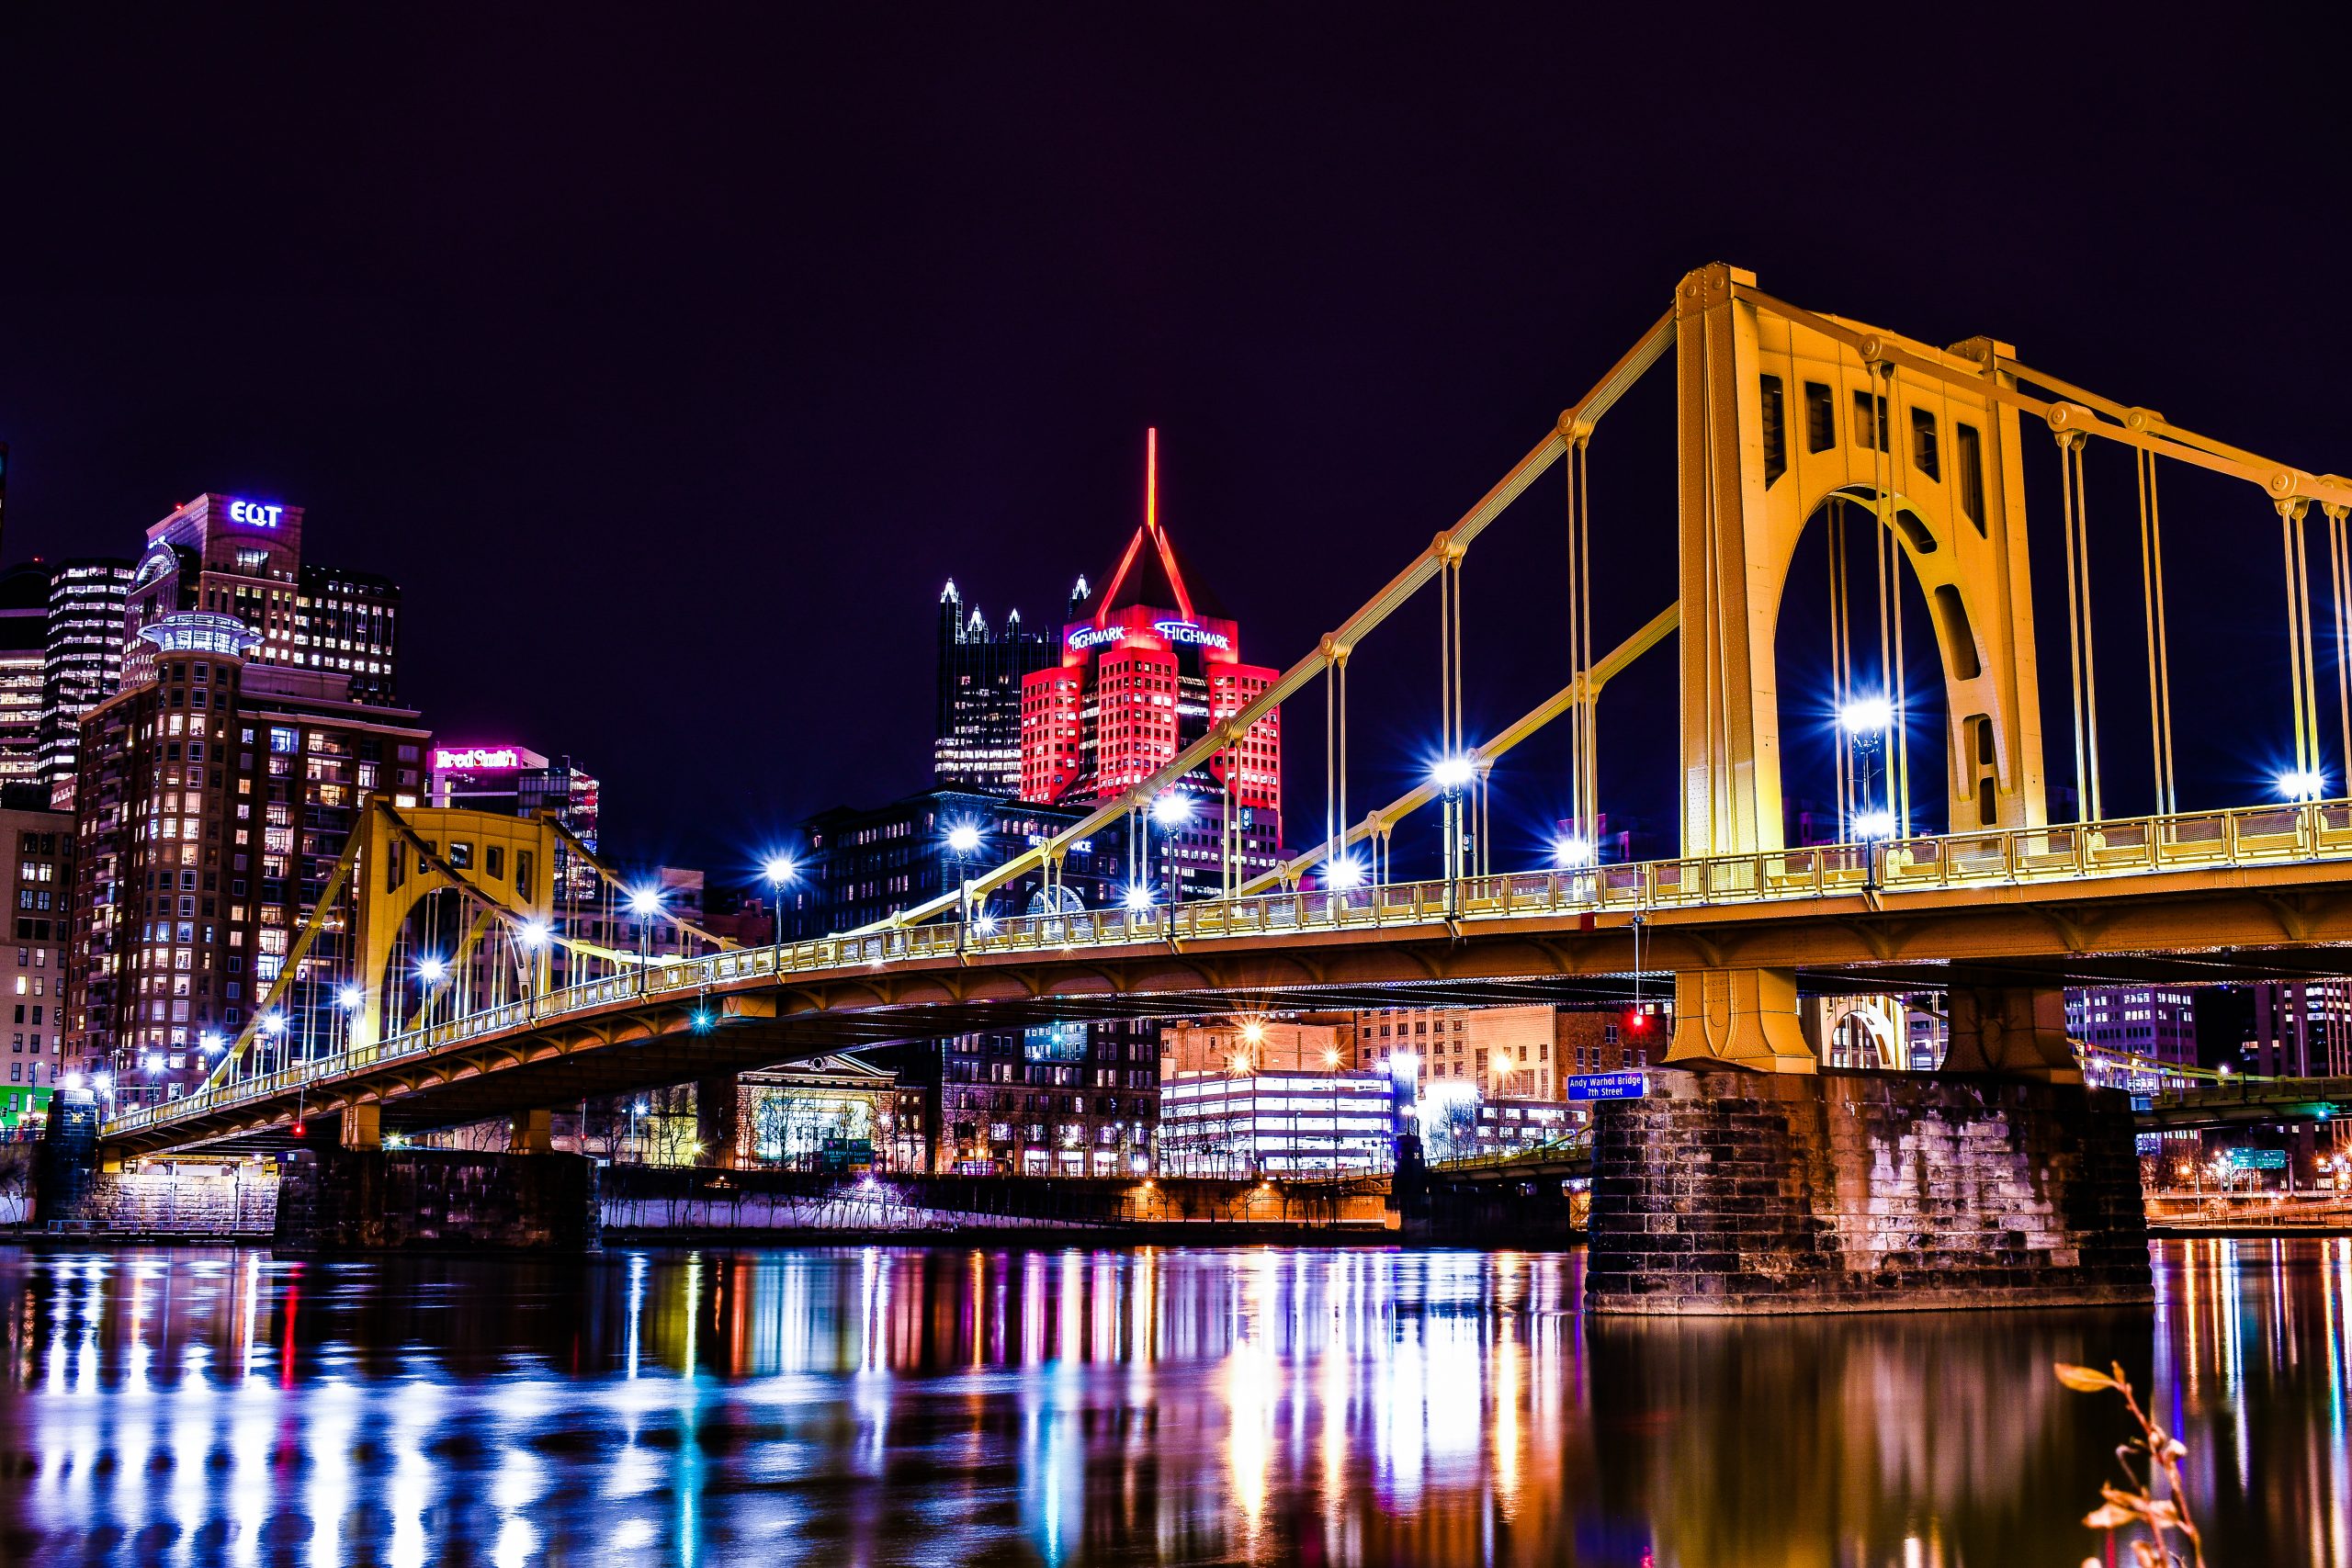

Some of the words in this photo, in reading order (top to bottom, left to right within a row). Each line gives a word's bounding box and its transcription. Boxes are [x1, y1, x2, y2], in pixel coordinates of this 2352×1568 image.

[231, 501, 282, 527] EQT
[1069, 626, 1125, 651] HIGHMARK
[1154, 620, 1230, 650] HIGHMARK
[1569, 1078, 1588, 1089] Andy
[1589, 1077, 1615, 1087] Warhol
[1617, 1076, 1642, 1087] Bridge
[1588, 1089, 1599, 1097] 7th
[1601, 1087, 1623, 1096] Street
